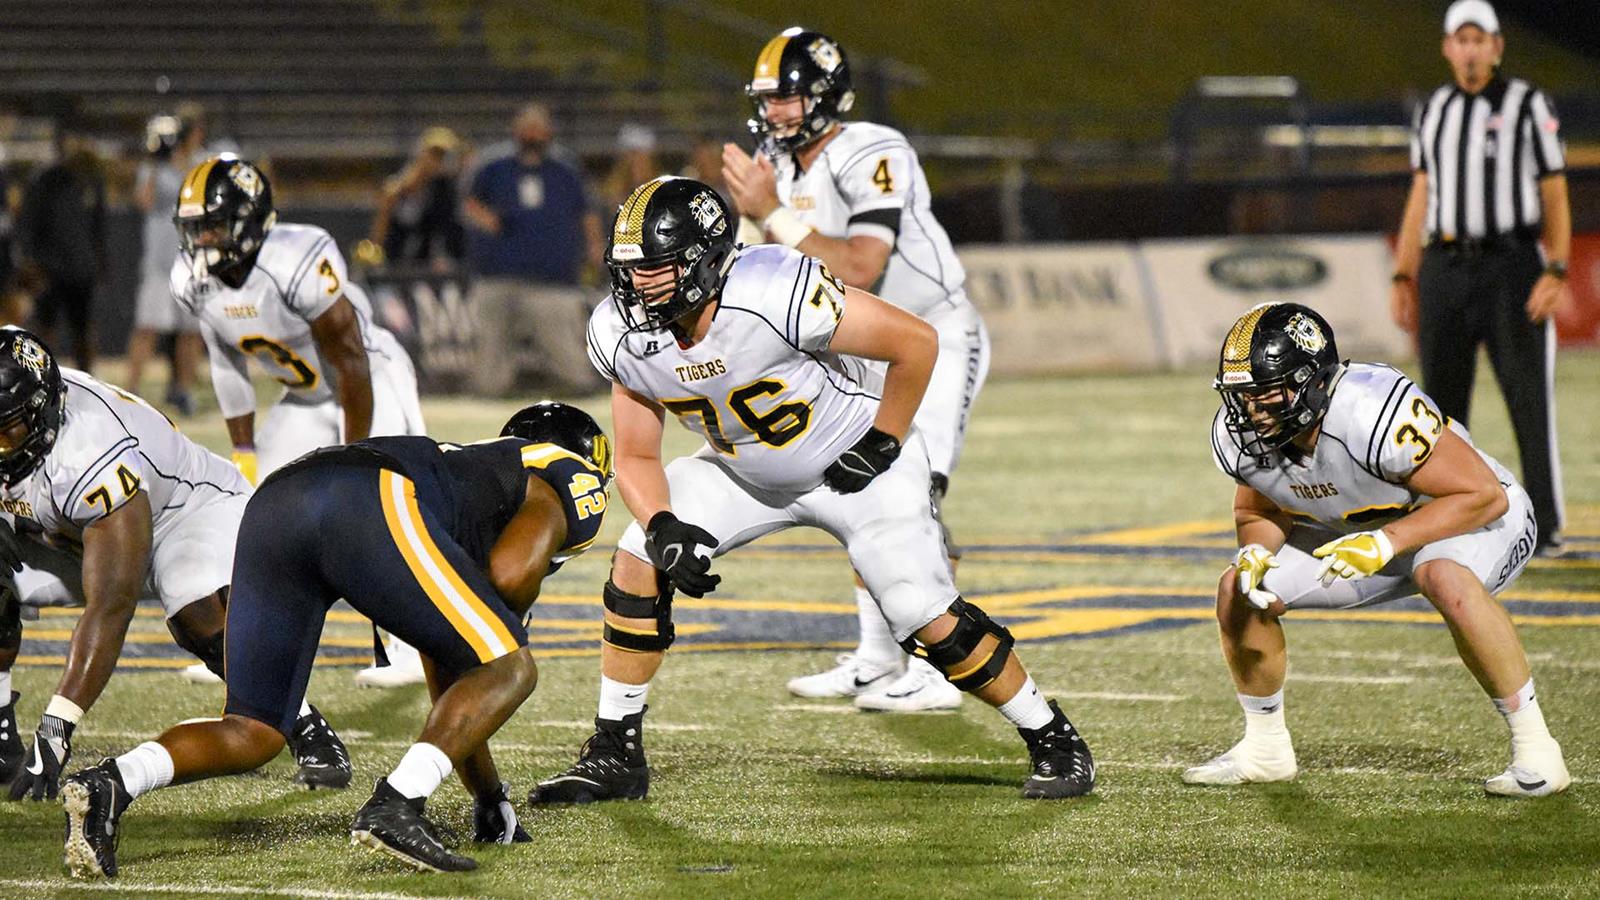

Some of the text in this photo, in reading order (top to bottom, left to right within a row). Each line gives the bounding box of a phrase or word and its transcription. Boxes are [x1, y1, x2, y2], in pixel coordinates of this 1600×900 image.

[871, 158, 894, 195] 4
[318, 256, 341, 296] 3
[239, 334, 321, 389] 3
[675, 358, 727, 383] TIGERS
[655, 377, 815, 459] 76
[1394, 396, 1442, 465] 33
[82, 462, 142, 516] 74
[567, 472, 607, 521] 42
[1289, 482, 1339, 500] TIGERS
[1488, 508, 1536, 595] TIGERS
